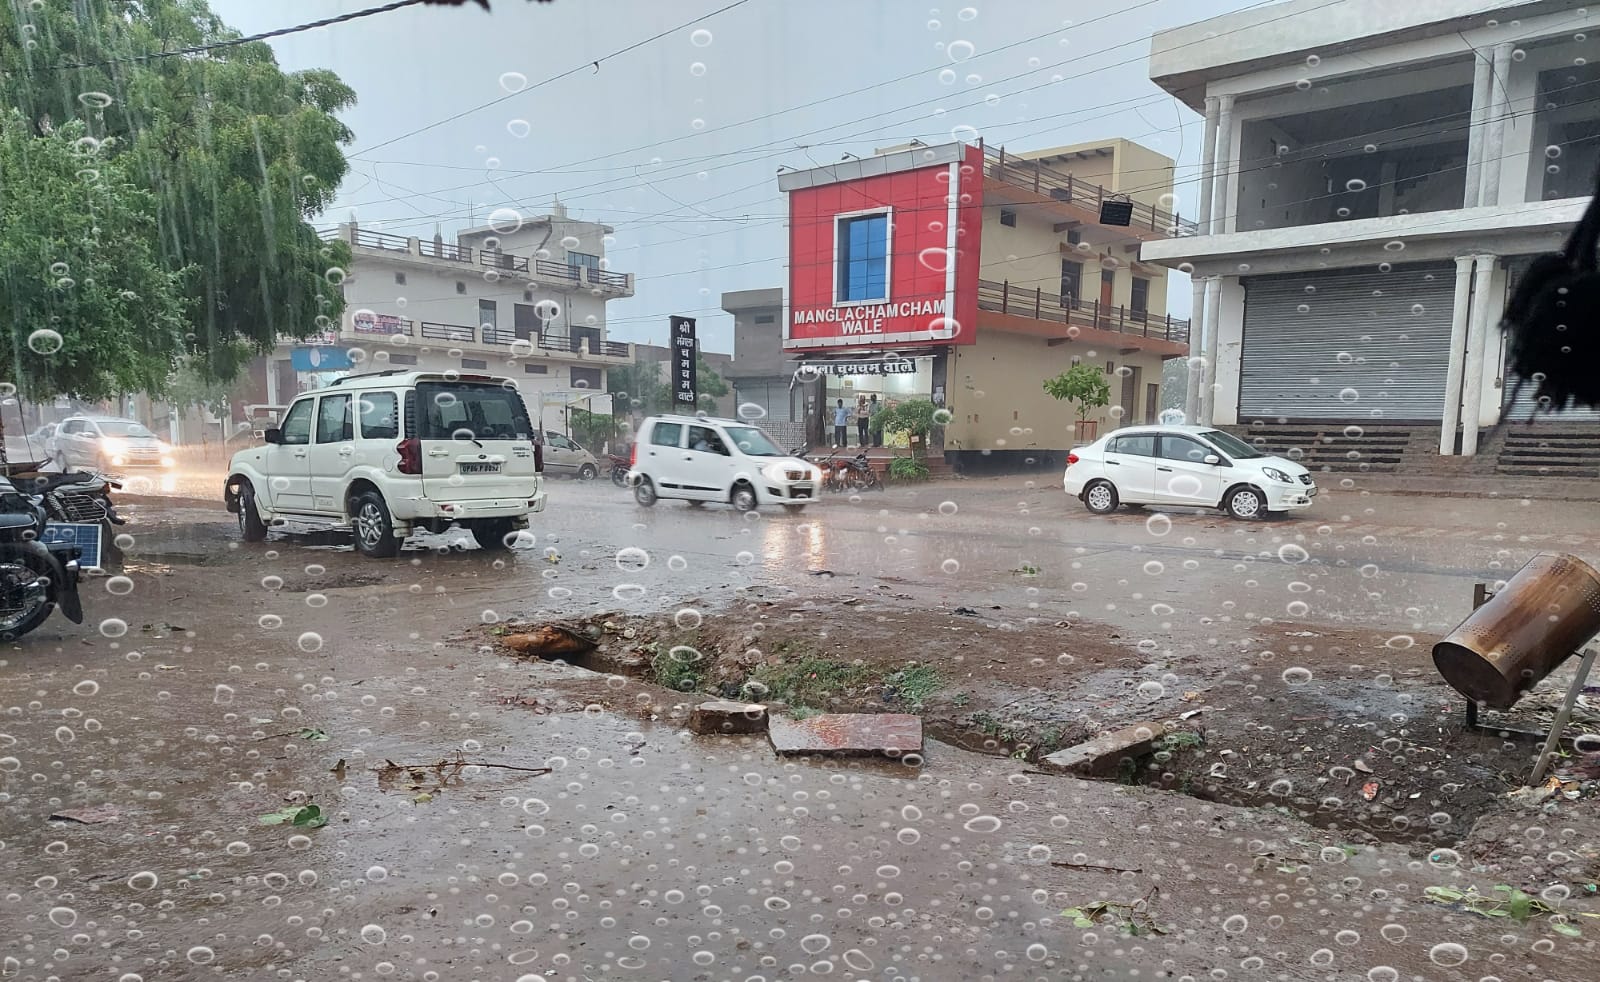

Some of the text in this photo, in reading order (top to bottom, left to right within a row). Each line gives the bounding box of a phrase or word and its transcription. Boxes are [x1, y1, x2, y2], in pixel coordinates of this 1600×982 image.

[679, 320, 690, 334] श्री
[841, 319, 883, 335] WALE
[882, 358, 914, 373] वाले
[677, 389, 695, 402] वाले
